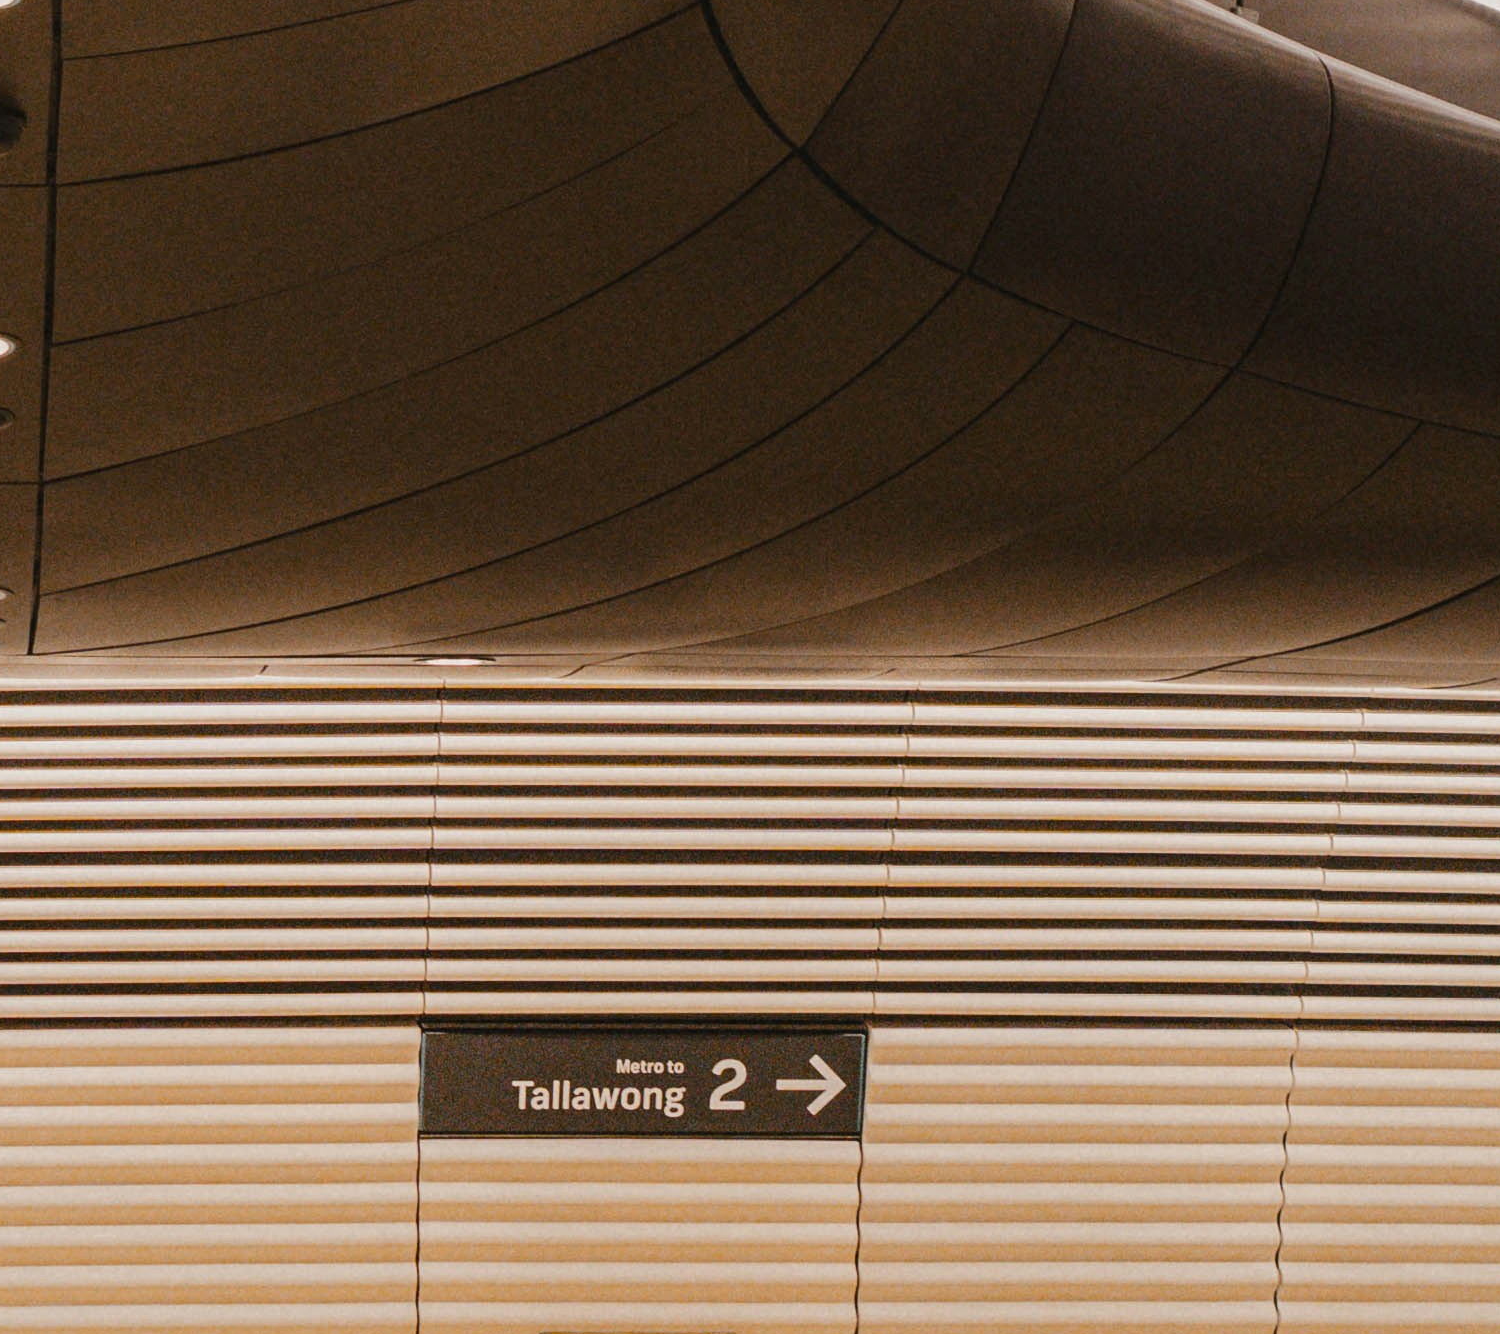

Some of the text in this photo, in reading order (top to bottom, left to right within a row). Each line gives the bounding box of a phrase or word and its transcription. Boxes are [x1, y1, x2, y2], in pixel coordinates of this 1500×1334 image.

[616, 1058, 685, 1074] Metro to
[708, 1058, 748, 1111] 2
[511, 1078, 687, 1117] Tallawong
